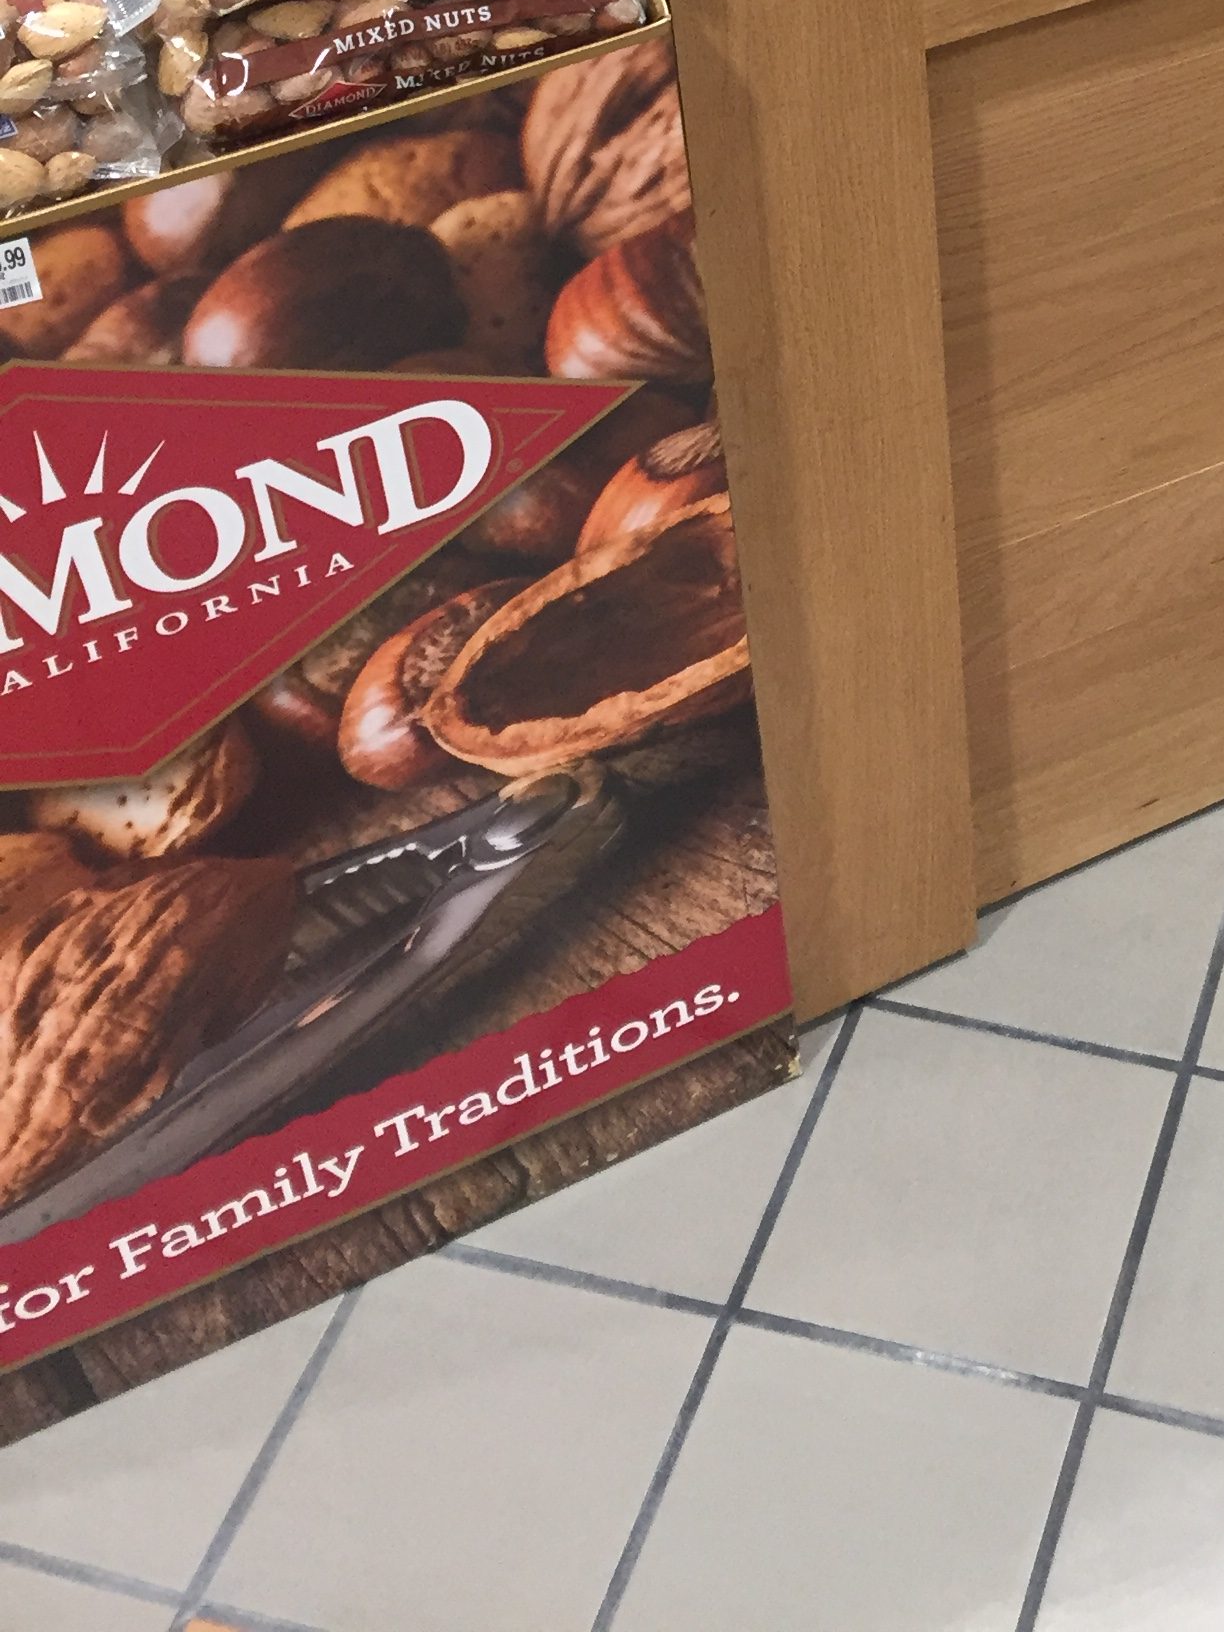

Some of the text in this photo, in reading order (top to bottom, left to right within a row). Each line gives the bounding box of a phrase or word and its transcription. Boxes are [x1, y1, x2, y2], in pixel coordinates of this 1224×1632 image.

[332, 18, 415, 56] MIXED
[424, 4, 493, 33] NUTS
[304, 84, 378, 115] DIAMOND
[0, 246, 26, 272] .99
[109, 1146, 366, 1282] Family
[374, 981, 742, 1161] Traditions.
